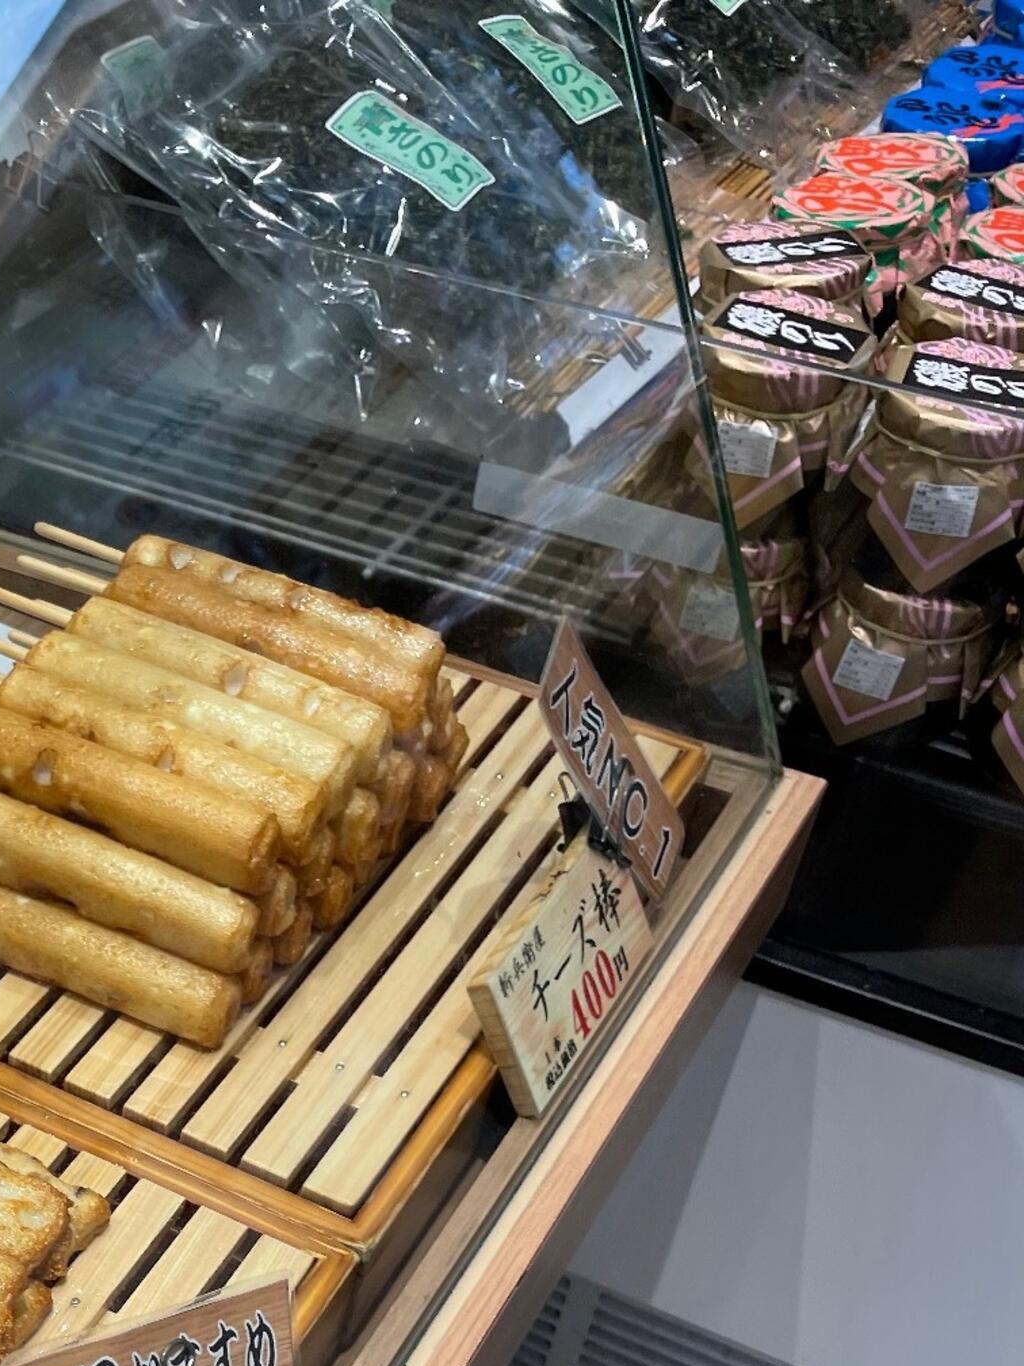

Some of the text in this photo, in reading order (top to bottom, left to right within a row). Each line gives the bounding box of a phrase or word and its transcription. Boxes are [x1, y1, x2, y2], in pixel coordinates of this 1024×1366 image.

[531, 868, 624, 1023] チーズ棒
[569, 944, 629, 1040] 400円
